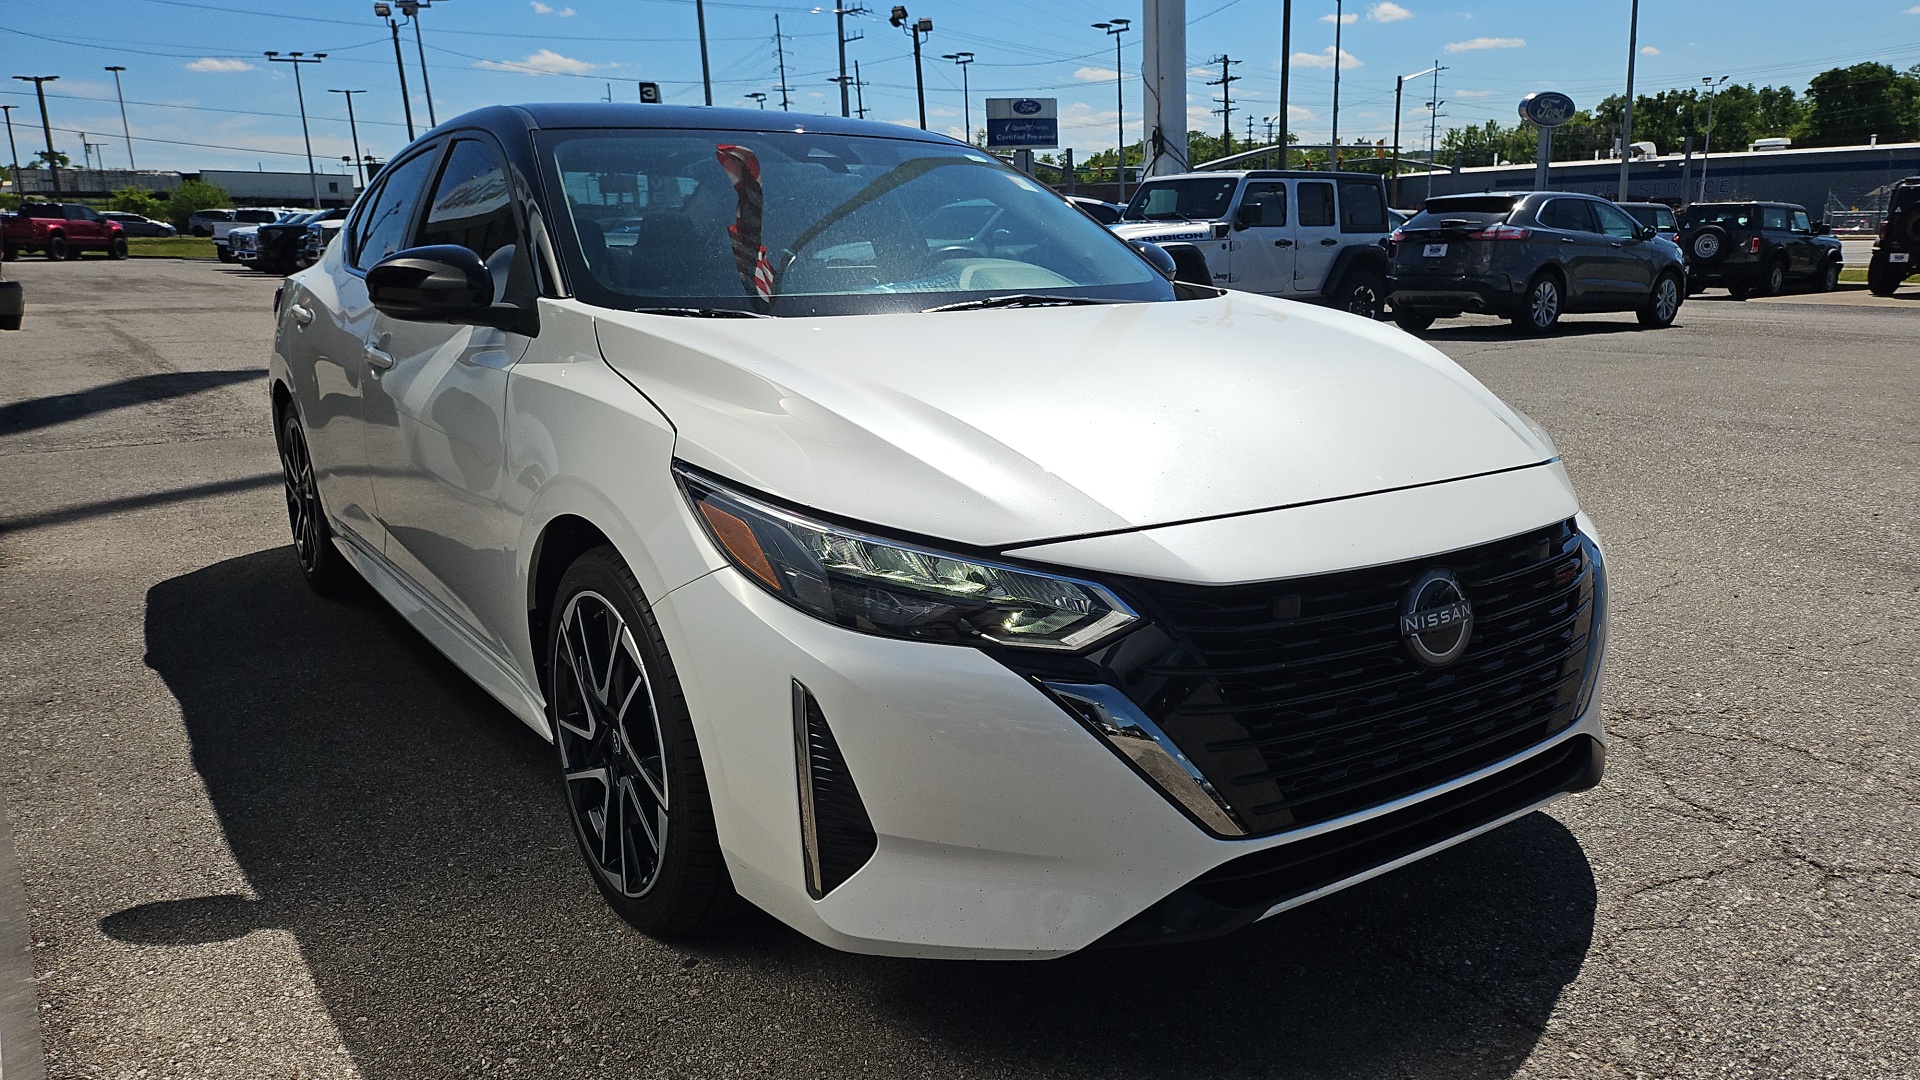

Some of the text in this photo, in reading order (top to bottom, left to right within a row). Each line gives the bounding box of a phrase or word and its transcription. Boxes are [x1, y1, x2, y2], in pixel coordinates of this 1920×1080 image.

[643, 87, 656, 100] 3
[1020, 102, 1037, 112] Ford
[1536, 98, 1567, 119] Ford
[1638, 179, 1730, 196] SERICE
[1141, 232, 1204, 242] RUBICON
[1213, 272, 1228, 281] Jeep
[1405, 602, 1471, 632] NISSAN
